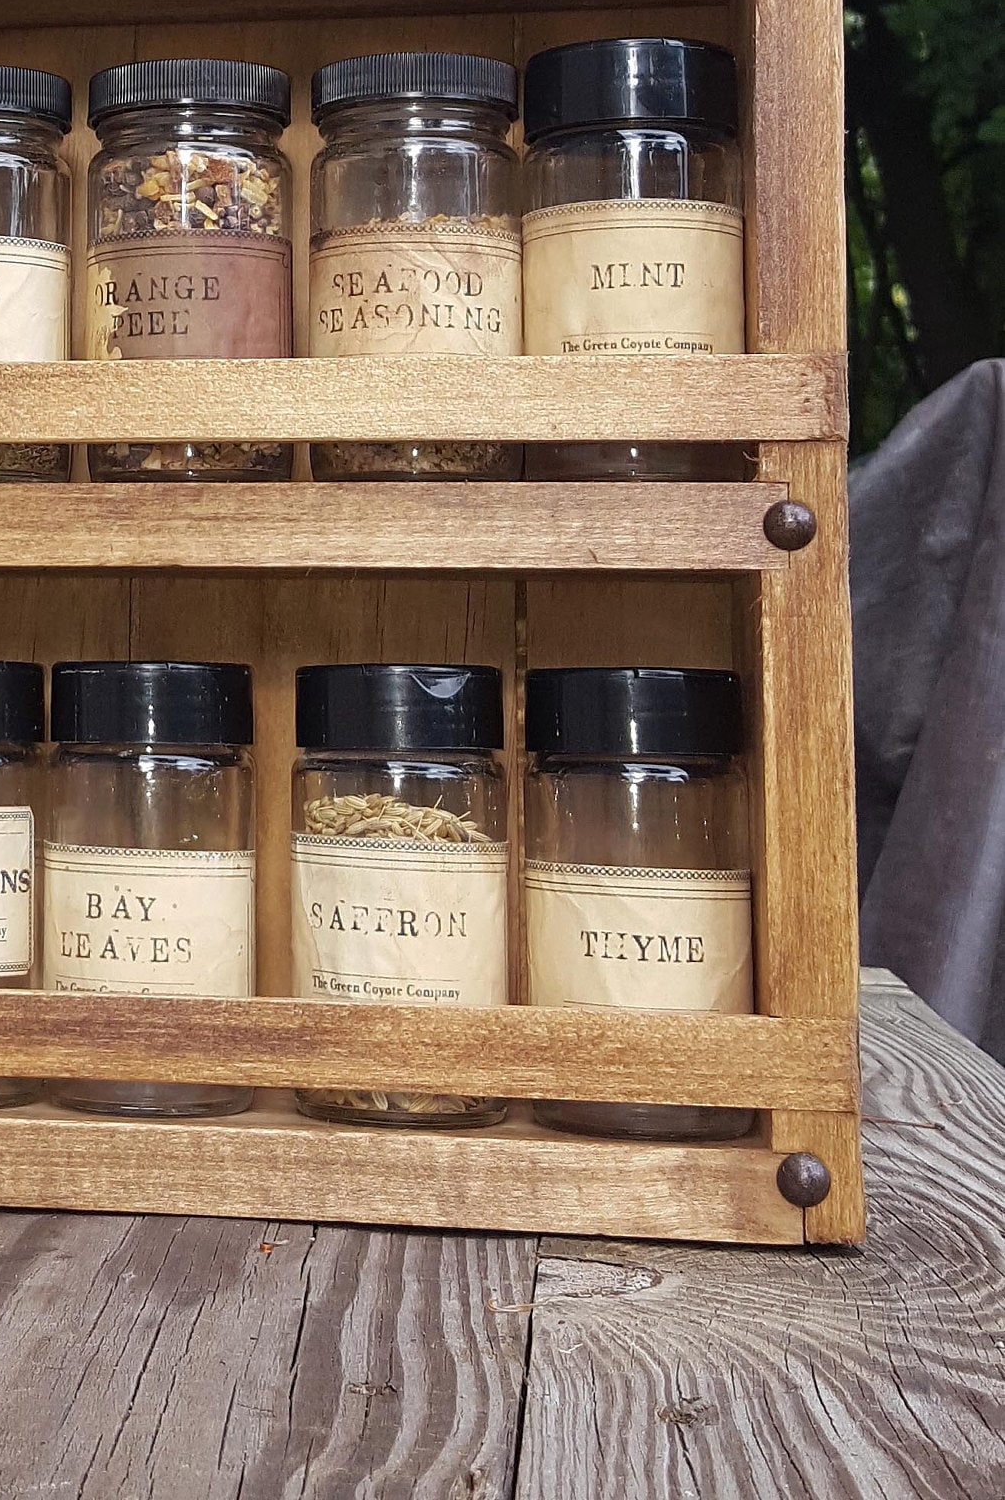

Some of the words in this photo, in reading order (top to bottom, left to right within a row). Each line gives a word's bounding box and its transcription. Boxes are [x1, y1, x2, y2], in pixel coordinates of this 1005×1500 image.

[95, 272, 220, 307] ORANGE
[332, 264, 483, 298] SEAFOOD
[590, 262, 686, 290] MINT
[112, 310, 191, 339] PEEL
[318, 299, 503, 334] SEASONING
[561, 341, 580, 354] The
[583, 339, 618, 351] Green
[620, 337, 662, 353] Coyote
[664, 337, 714, 354] Company
[85, 887, 158, 922] BAY
[309, 900, 467, 938] SAFFRON
[60, 929, 192, 964] LEAVES
[580, 930, 705, 964] THYME
[312, 975, 328, 990] The
[330, 977, 361, 993] Green
[363, 981, 403, 998] Coyote
[406, 984, 461, 1000] Company
